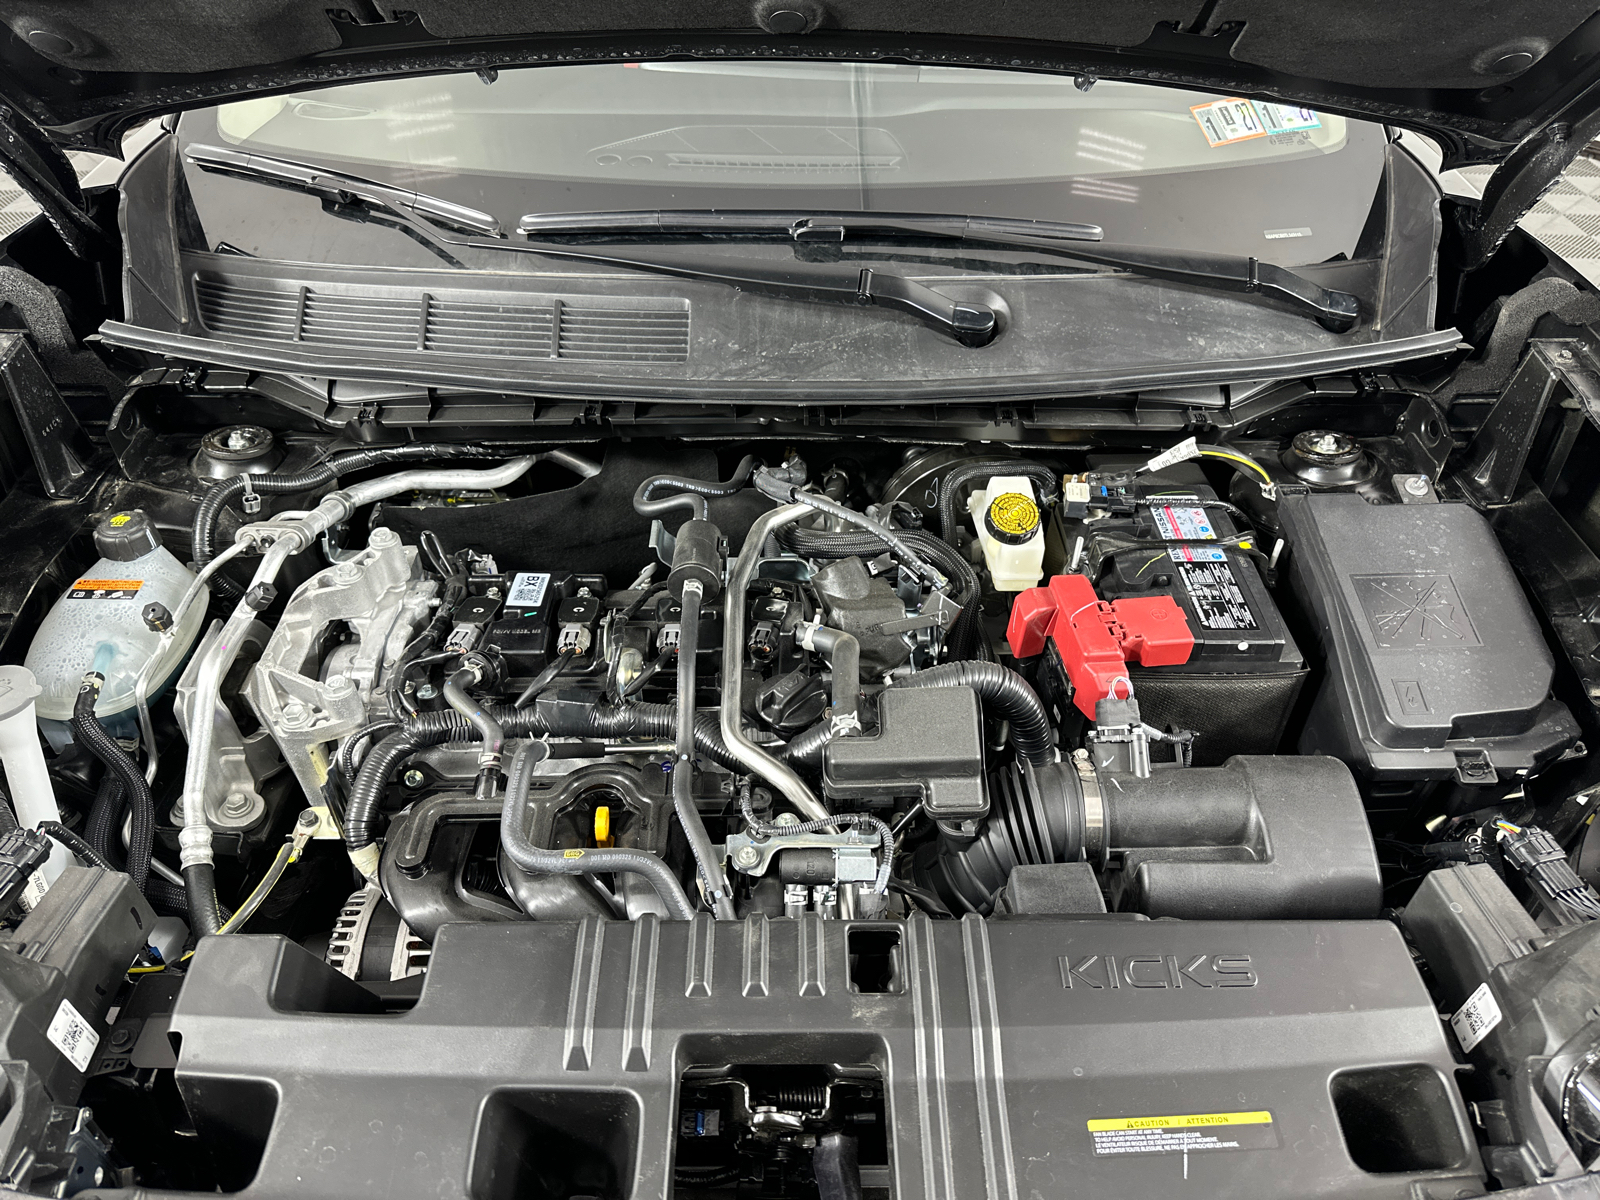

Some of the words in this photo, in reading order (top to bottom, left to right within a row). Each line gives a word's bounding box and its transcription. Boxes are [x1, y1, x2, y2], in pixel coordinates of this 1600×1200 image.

[524, 575, 540, 588] BX
[1057, 953, 1259, 989] KICKS
[1134, 1119, 1170, 1128] CAUTION
[1186, 1116, 1229, 1125] ATTENTION
